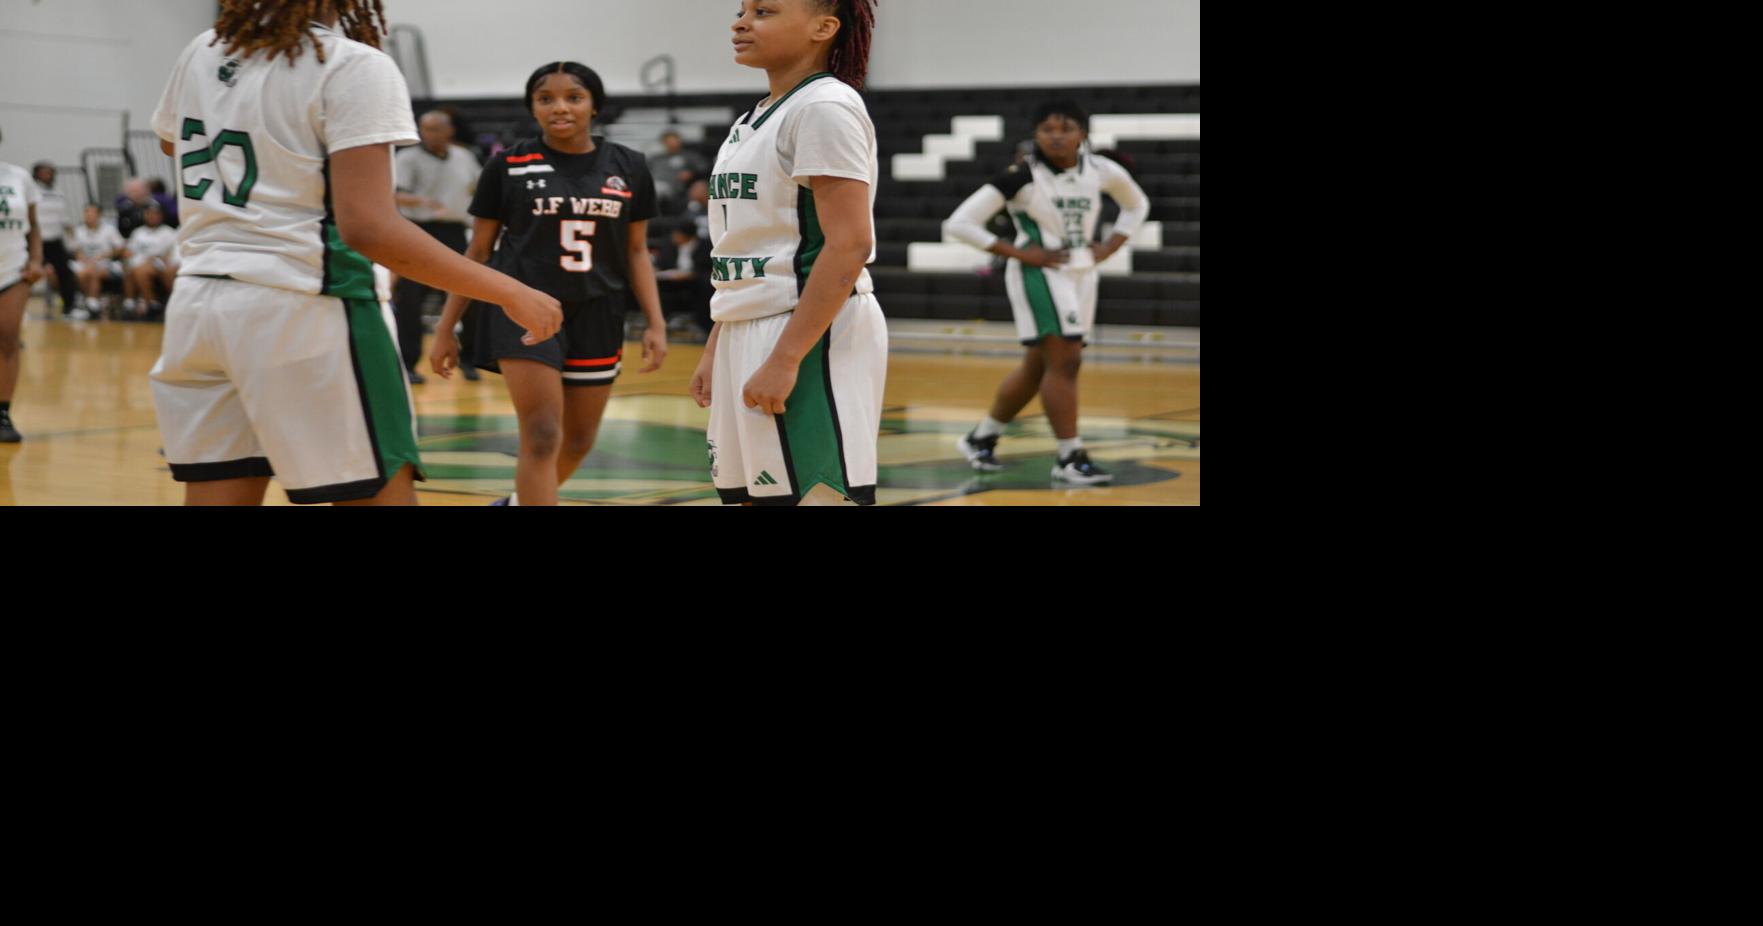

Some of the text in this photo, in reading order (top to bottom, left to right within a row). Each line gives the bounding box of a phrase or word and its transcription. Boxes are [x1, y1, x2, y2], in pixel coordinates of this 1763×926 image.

[181, 117, 258, 208] 20
[532, 197, 622, 218] J.F WEBB
[560, 219, 596, 272] 5
